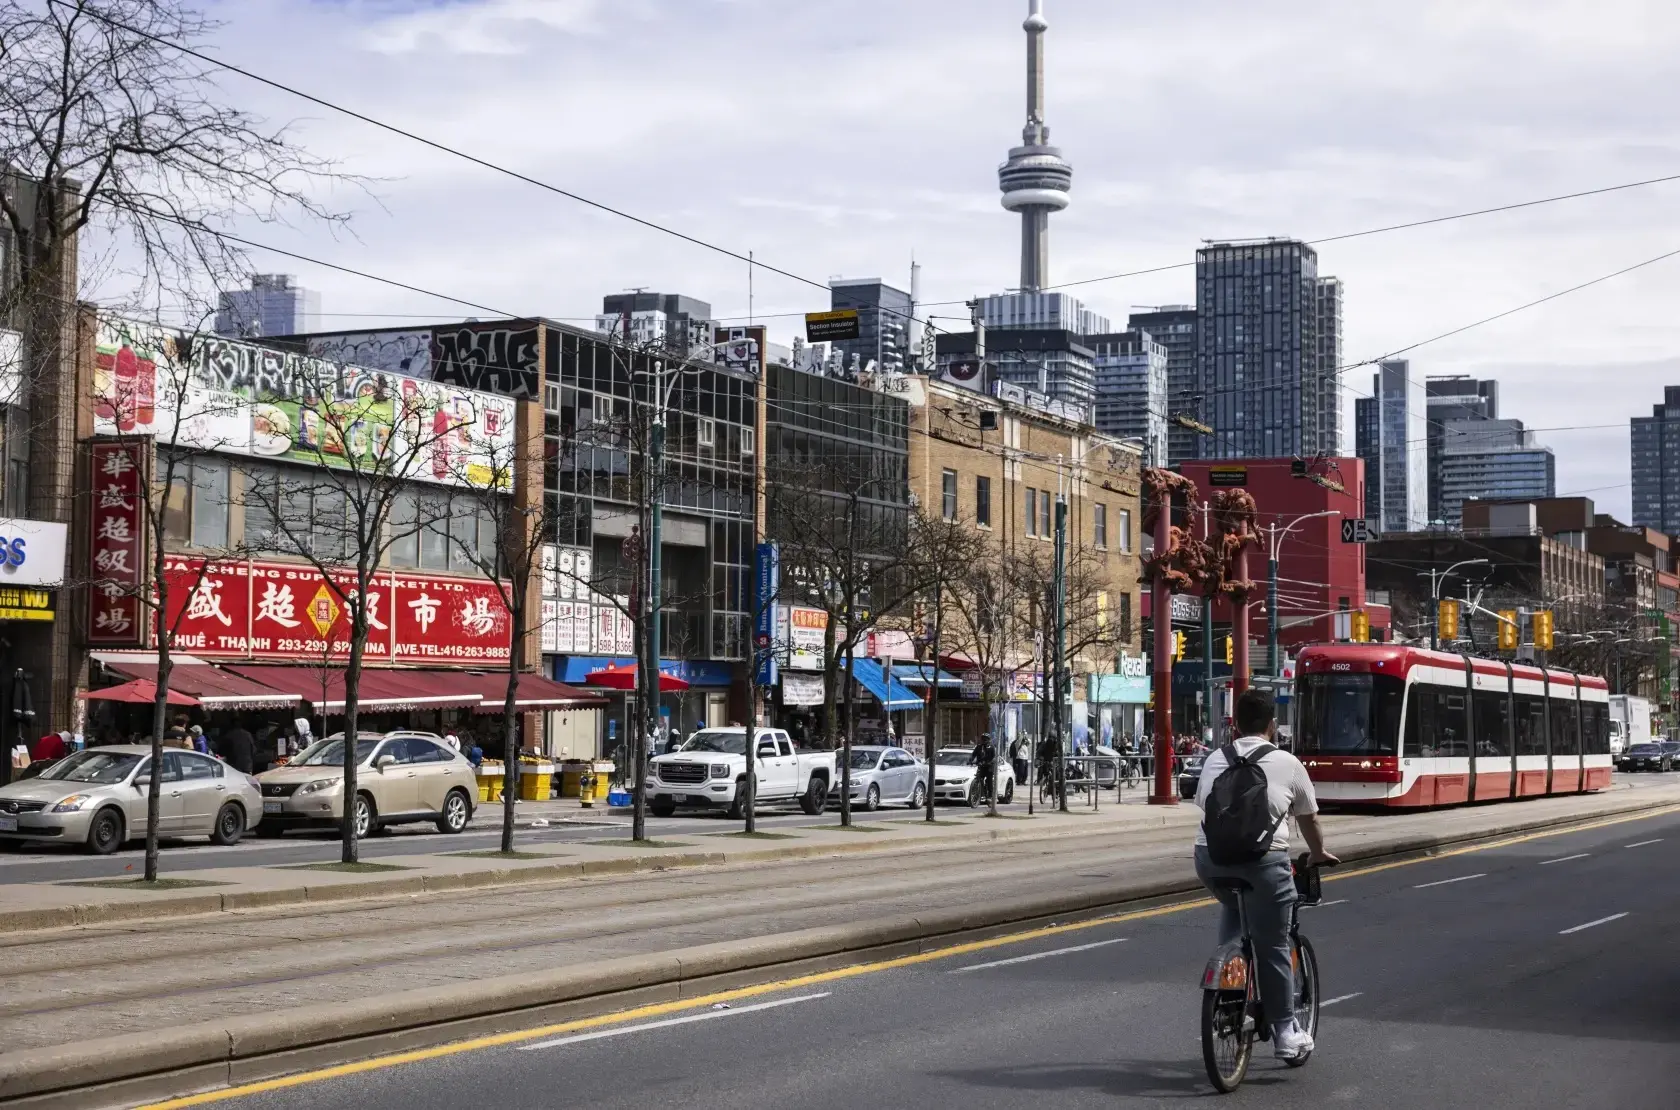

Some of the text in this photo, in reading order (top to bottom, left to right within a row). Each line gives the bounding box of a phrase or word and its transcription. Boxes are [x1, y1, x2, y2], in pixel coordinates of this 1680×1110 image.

[164, 390, 190, 405] FOD
[208, 391, 233, 405] LUNCH
[206, 565, 280, 579] SHENG
[433, 583, 469, 593] LTD.
[760, 554, 768, 595] Montreal
[22, 590, 49, 608] WU
[277, 639, 328, 651] 293-299
[333, 640, 386, 654] SPINA
[1121, 650, 1147, 680] Rexall
[1331, 663, 1351, 671] 4502
